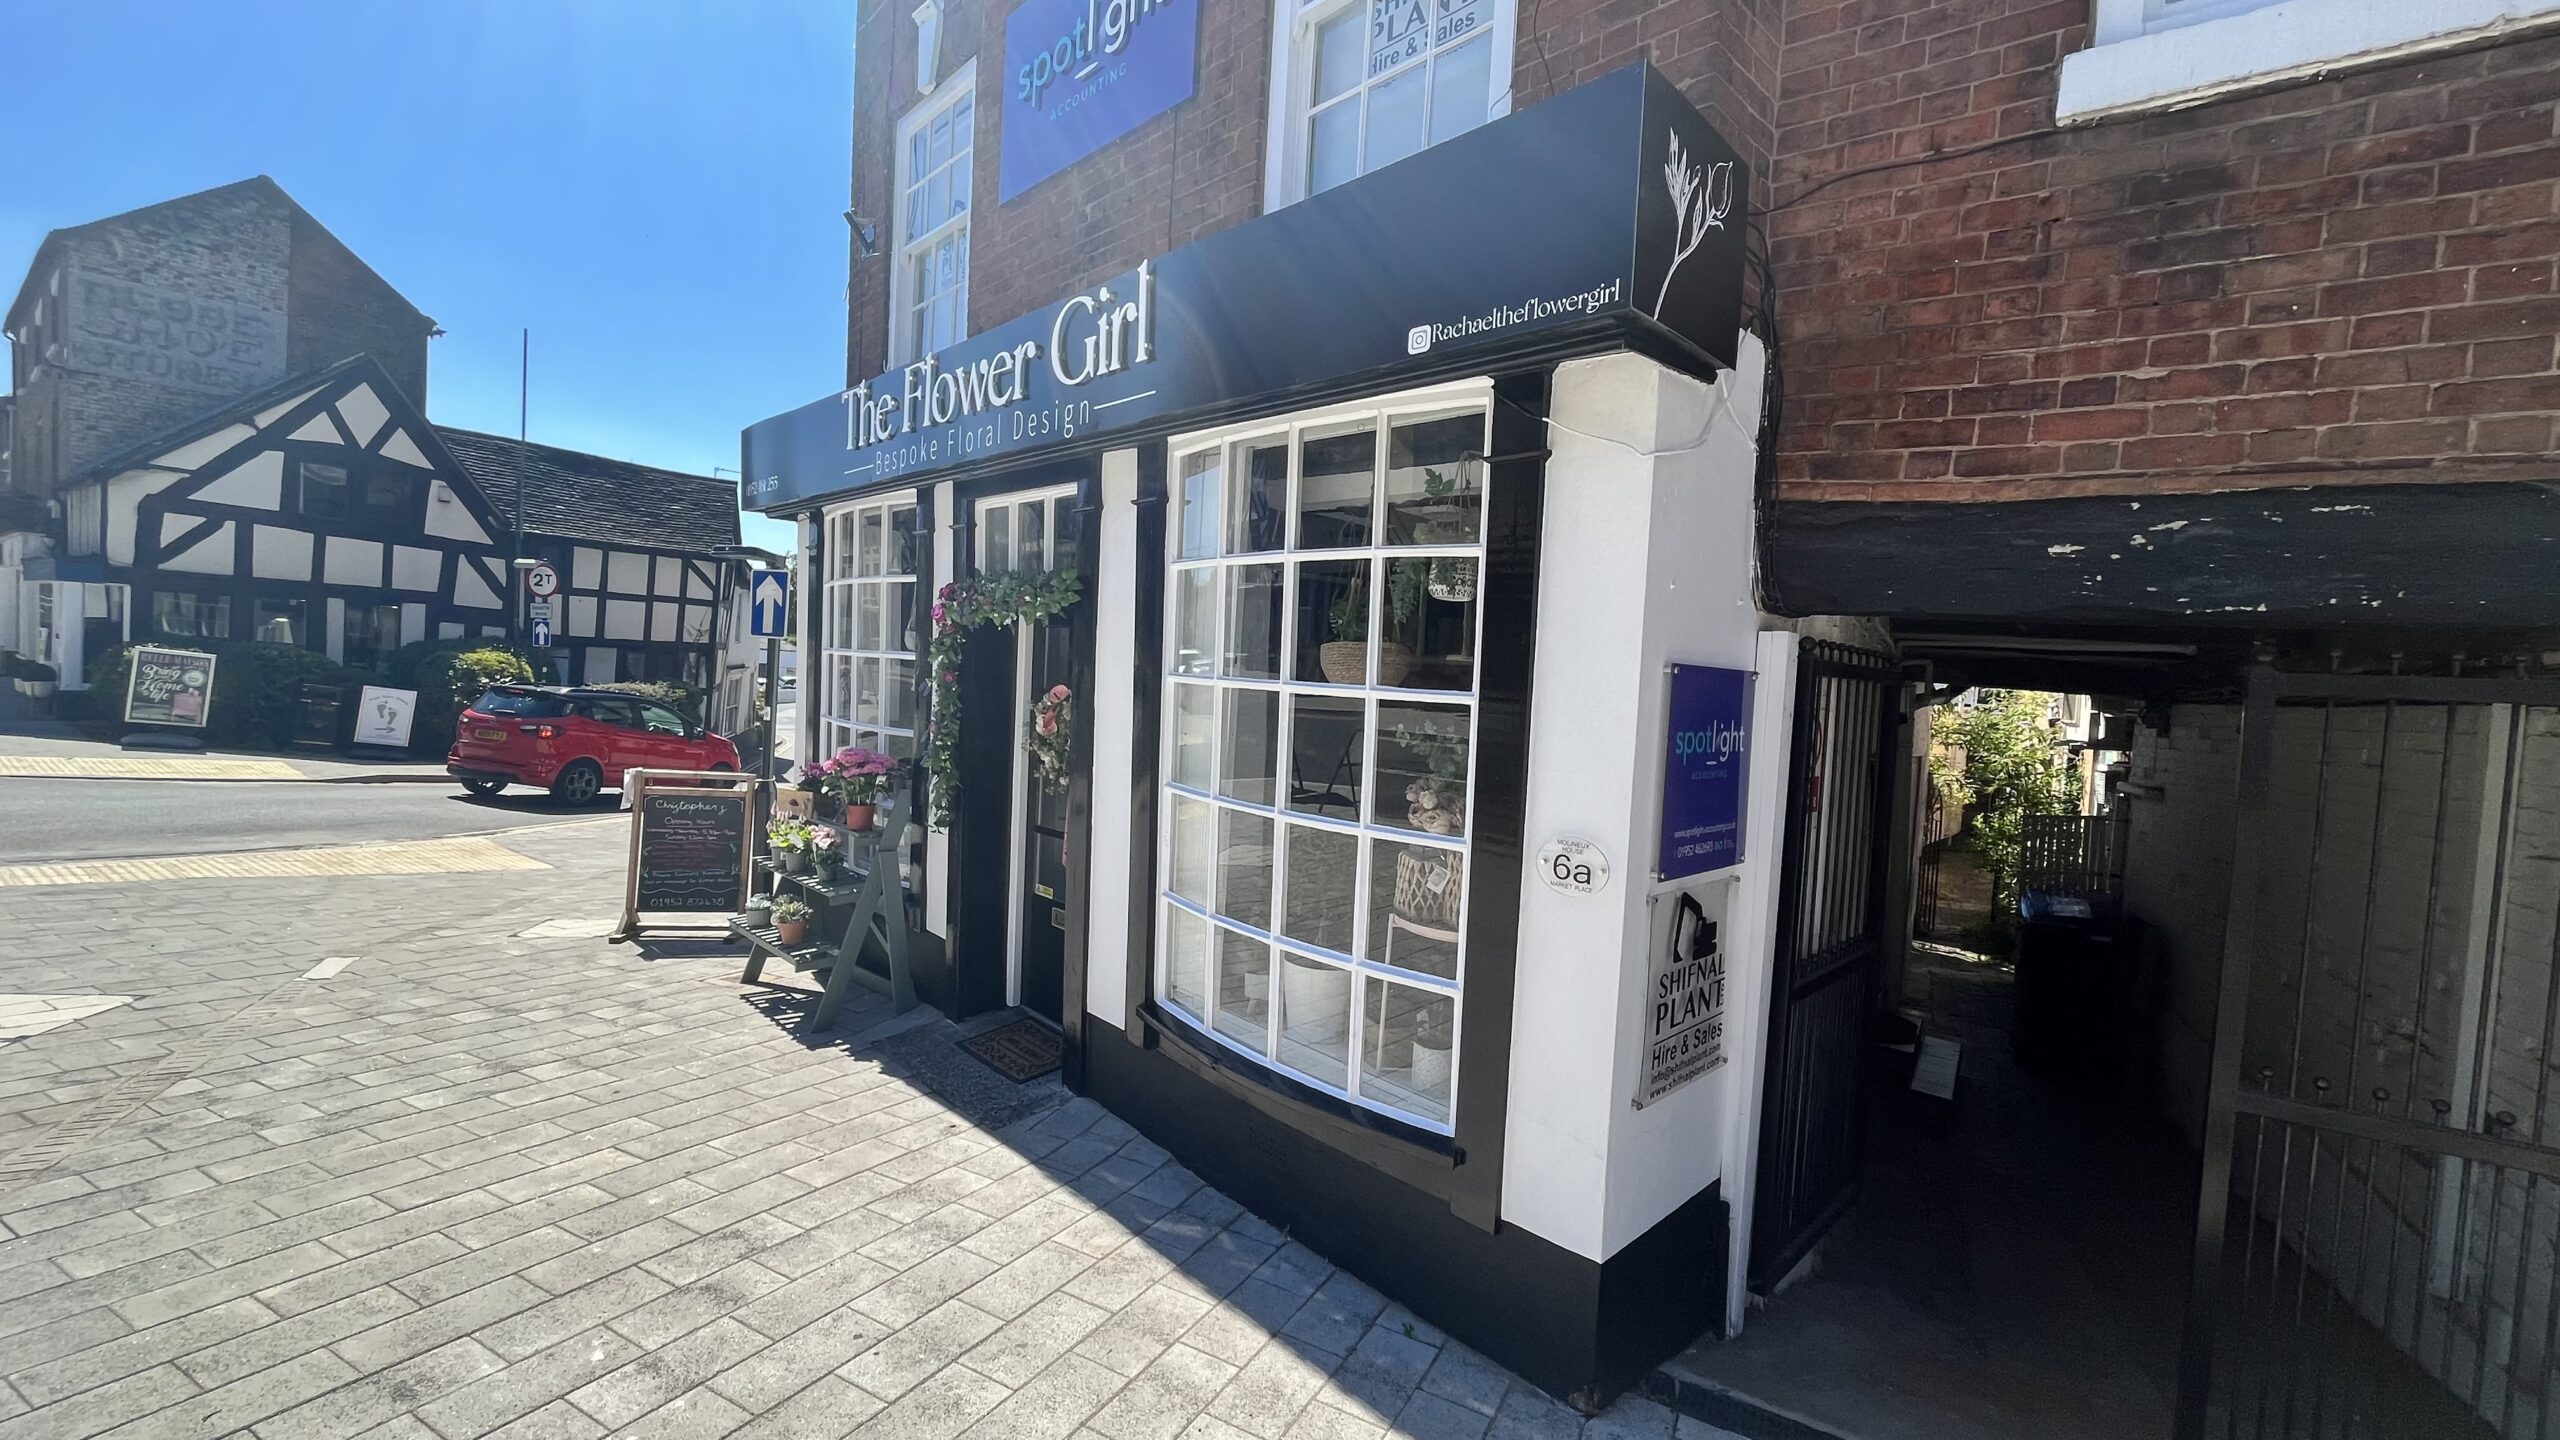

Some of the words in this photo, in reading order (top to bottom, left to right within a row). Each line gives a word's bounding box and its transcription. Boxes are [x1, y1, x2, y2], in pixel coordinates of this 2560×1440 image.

[1406, 37, 1417, 57] &
[1050, 62, 1127, 121] ACCOUNTING
[1432, 278, 1620, 342] Rachaeltheflowergirl
[842, 378, 894, 450] The
[901, 340, 1036, 433] Flower
[1051, 259, 1150, 386] Girl
[876, 434, 938, 475] Bespoke
[947, 413, 1000, 456] Floral
[1013, 399, 1089, 440] Design
[533, 574, 552, 587] 2T
[137, 679, 184, 692] Home
[142, 664, 181, 682] Bring
[1675, 720, 1745, 766] spotlight
[1557, 839, 1590, 849] MOLINEUX
[1562, 847, 1584, 855] HOUSE
[1550, 880, 1573, 889] MARKET
[1574, 884, 1593, 894] PLACE
[1553, 854, 1591, 885] 6a
[651, 898, 682, 906] 01952
[1659, 953, 1725, 999] SHIFNAL
[1655, 977, 1725, 1036] PLANT
[1650, 1043, 1721, 1085] info@shifnalplant.com
[1651, 1043, 1677, 1071] Hire
[1680, 1033, 1689, 1055] &
[1693, 1022, 1723, 1049] Sales
[1649, 1057, 1720, 1099] www.shifnalplant.com
